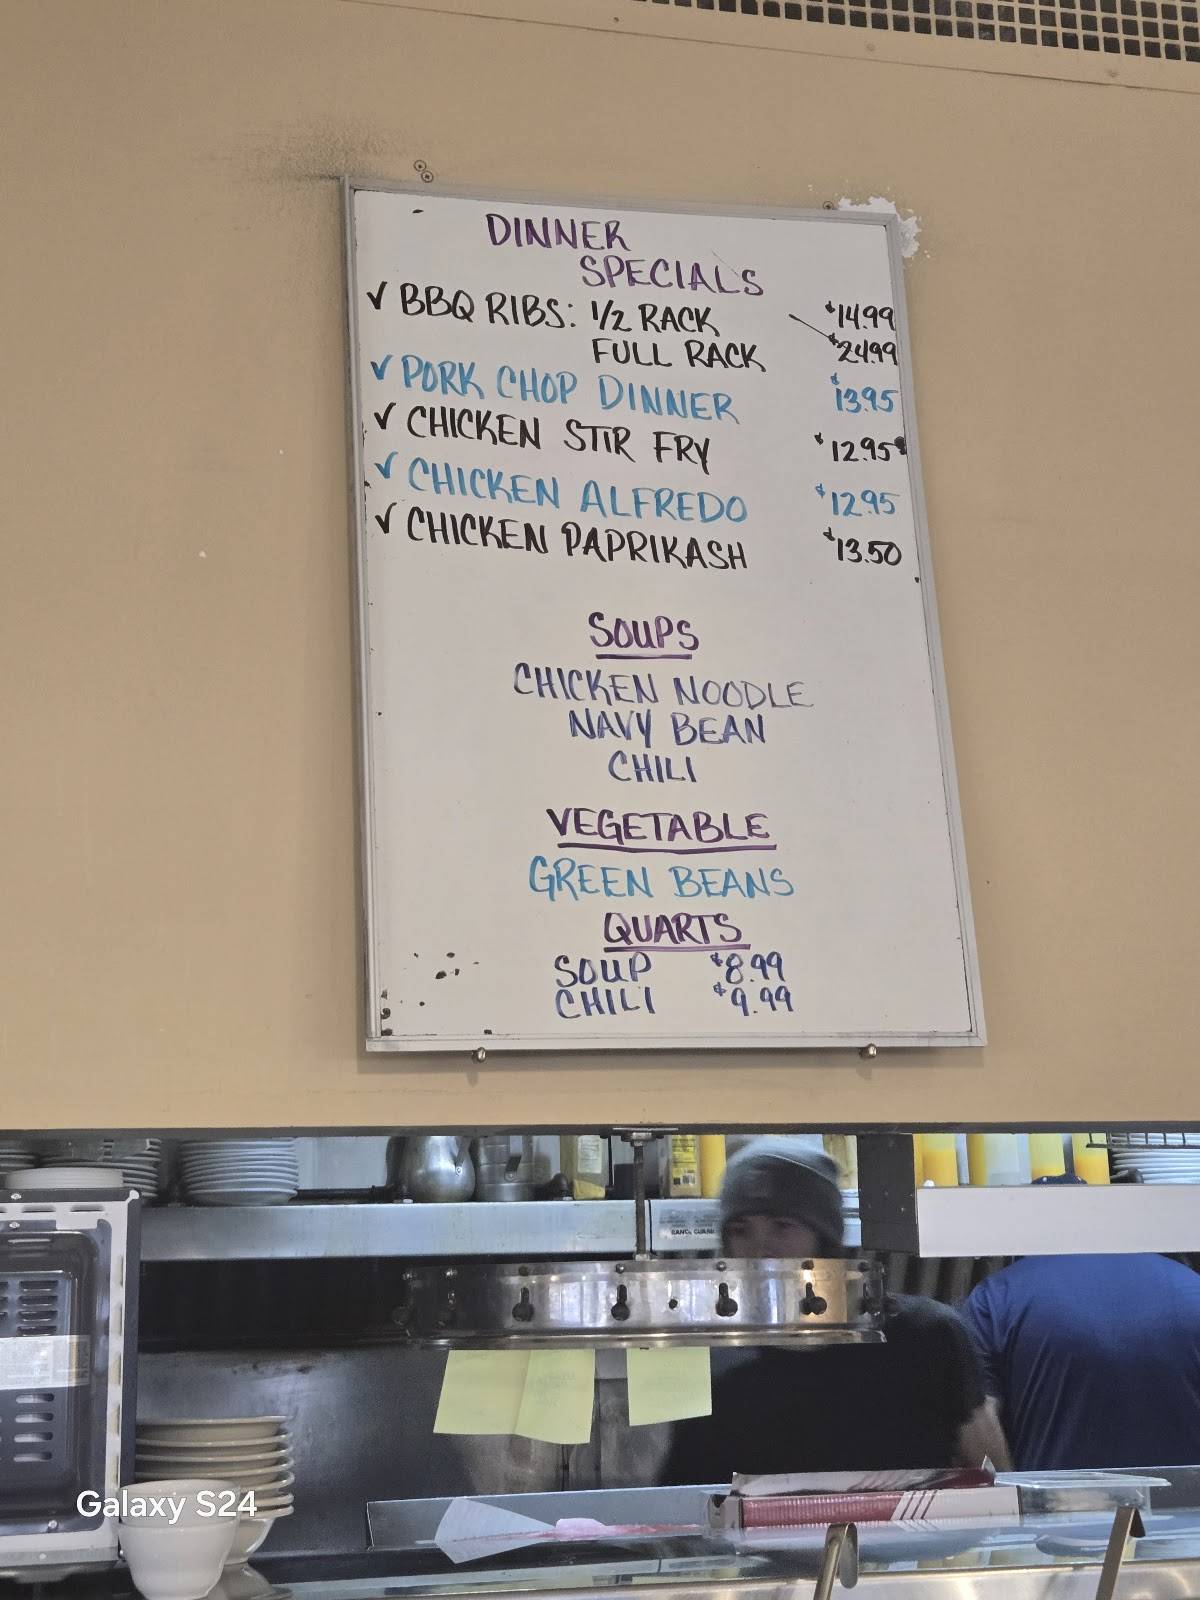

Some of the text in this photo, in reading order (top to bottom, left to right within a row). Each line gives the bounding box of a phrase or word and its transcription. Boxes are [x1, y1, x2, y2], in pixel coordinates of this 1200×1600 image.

[486, 213, 631, 251] DINNER
[580, 255, 764, 296] SPECIALS
[400, 283, 896, 337] BBQ RIBS: 1/2 RACK $14.99
[592, 333, 898, 372] FULL RACK $24.99
[401, 355, 898, 424] PORK CHOP DINNER $13.95
[407, 406, 541, 449] CHICKEN
[564, 419, 635, 462] STIR
[653, 431, 710, 475] FRY
[408, 457, 559, 509] CHICKEN
[580, 480, 748, 523] ALFREDO
[407, 506, 902, 569] CHICKEN PAPRIKASH $13.50
[588, 612, 699, 650] SOUPS
[513, 662, 814, 710] CHICKEN NOODLE
[569, 708, 765, 748] NAVY BEAN
[608, 750, 697, 783] CHILI
[546, 807, 770, 845] VEGETABLE
[529, 855, 794, 901] GREEN BEANS
[603, 912, 742, 945] QUARTS
[554, 951, 786, 987] SOUP $8.99
[555, 982, 794, 1018] CHILI $9.99
